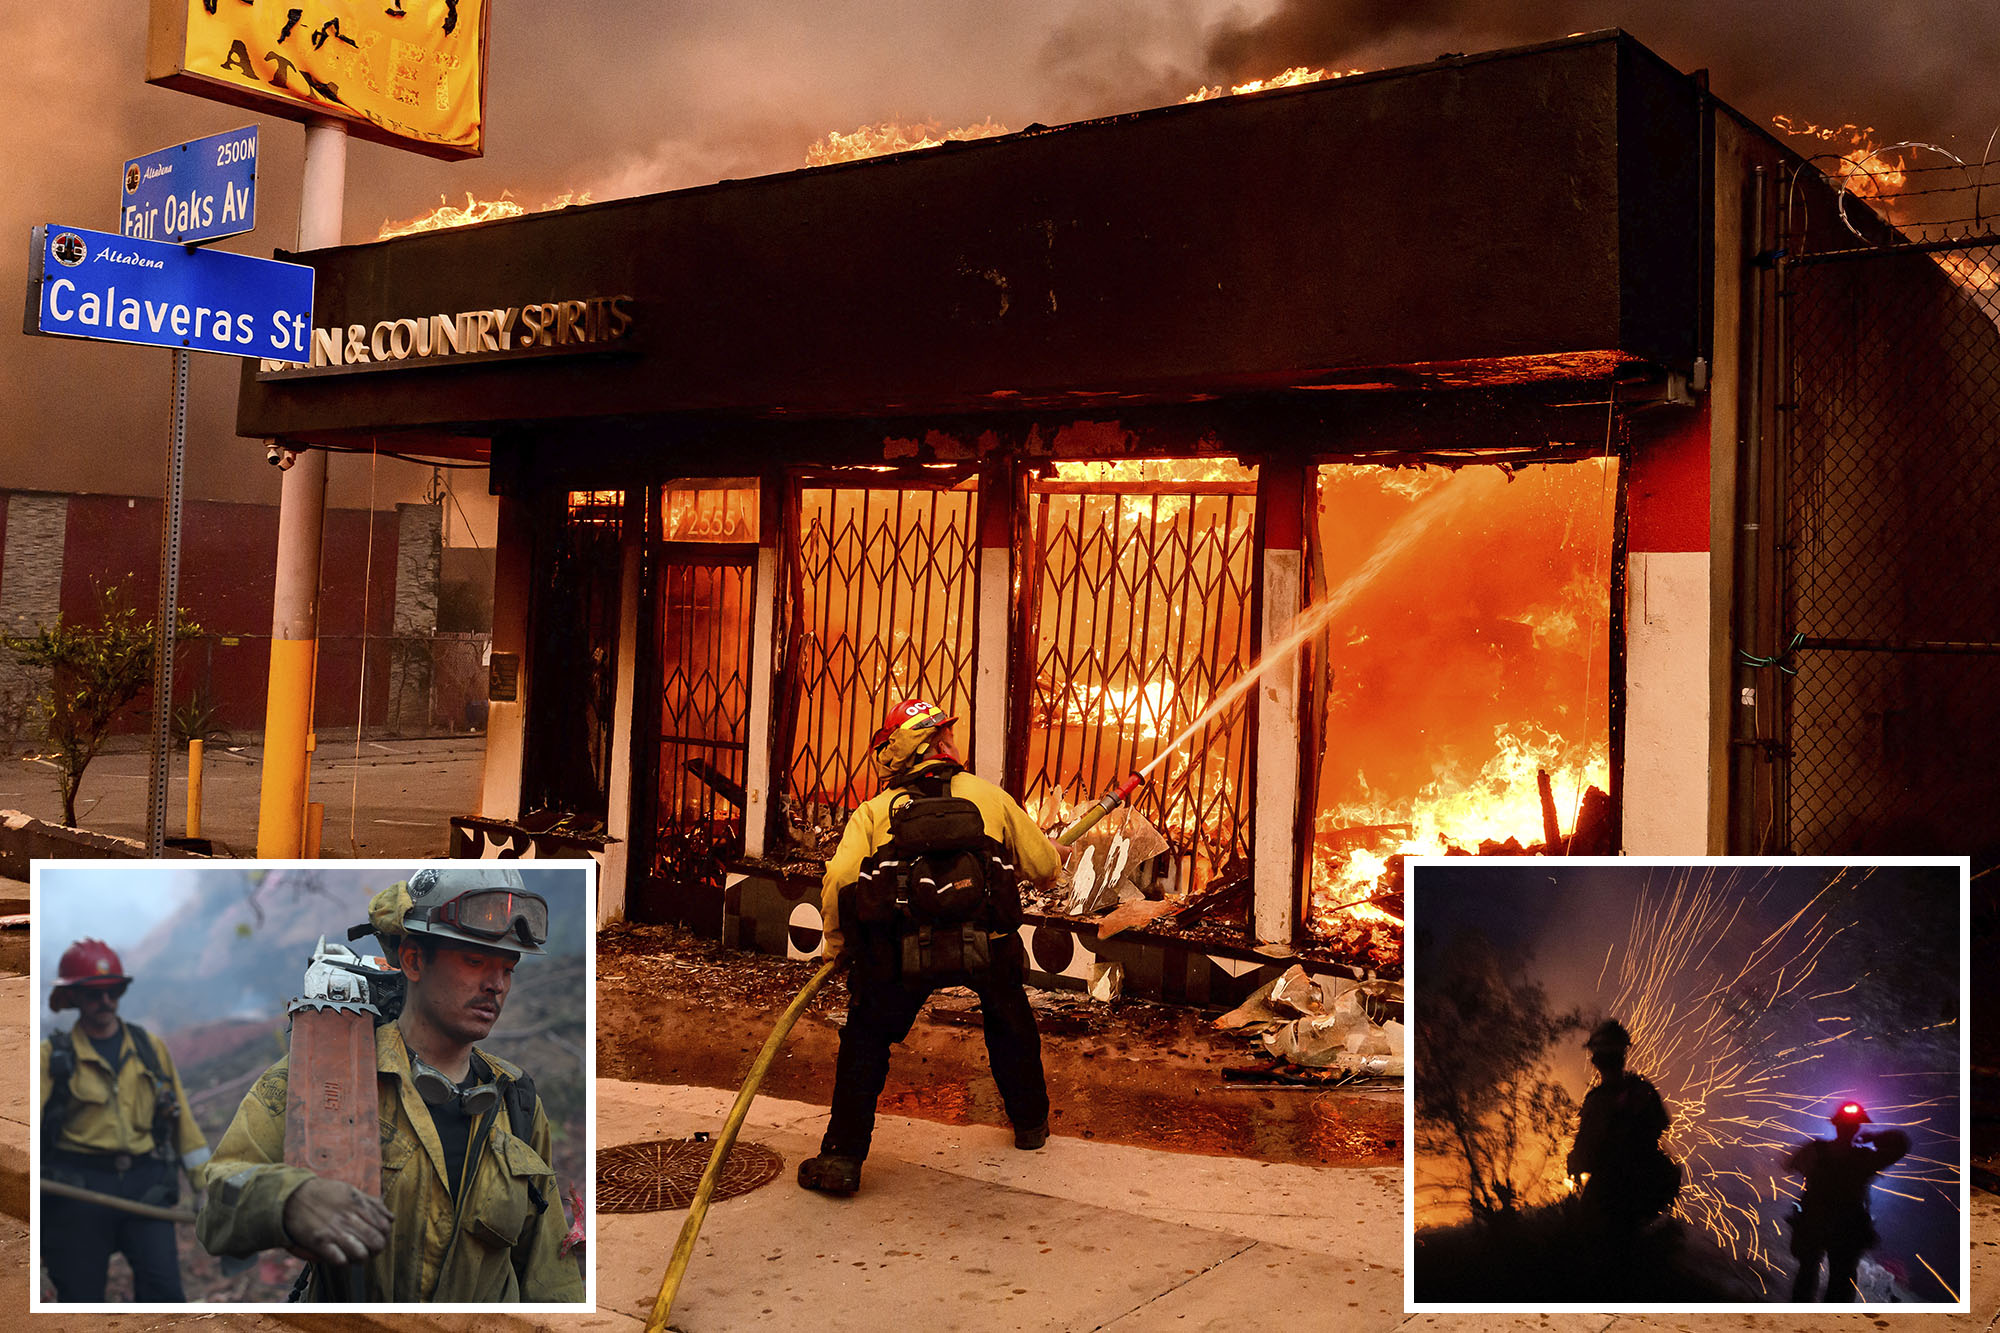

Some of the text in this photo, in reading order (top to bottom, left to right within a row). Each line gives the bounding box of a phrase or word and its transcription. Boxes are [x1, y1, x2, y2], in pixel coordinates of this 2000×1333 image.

[217, 136, 256, 166] 2500N
[142, 163, 173, 184] Altadena
[125, 181, 250, 239] Fair Oaks Av
[94, 247, 165, 270] Altadena
[49, 278, 255, 345] Calaveras
[270, 309, 306, 352] St
[371, 307, 519, 362] COUNTRY
[520, 294, 634, 348] SPIRITS
